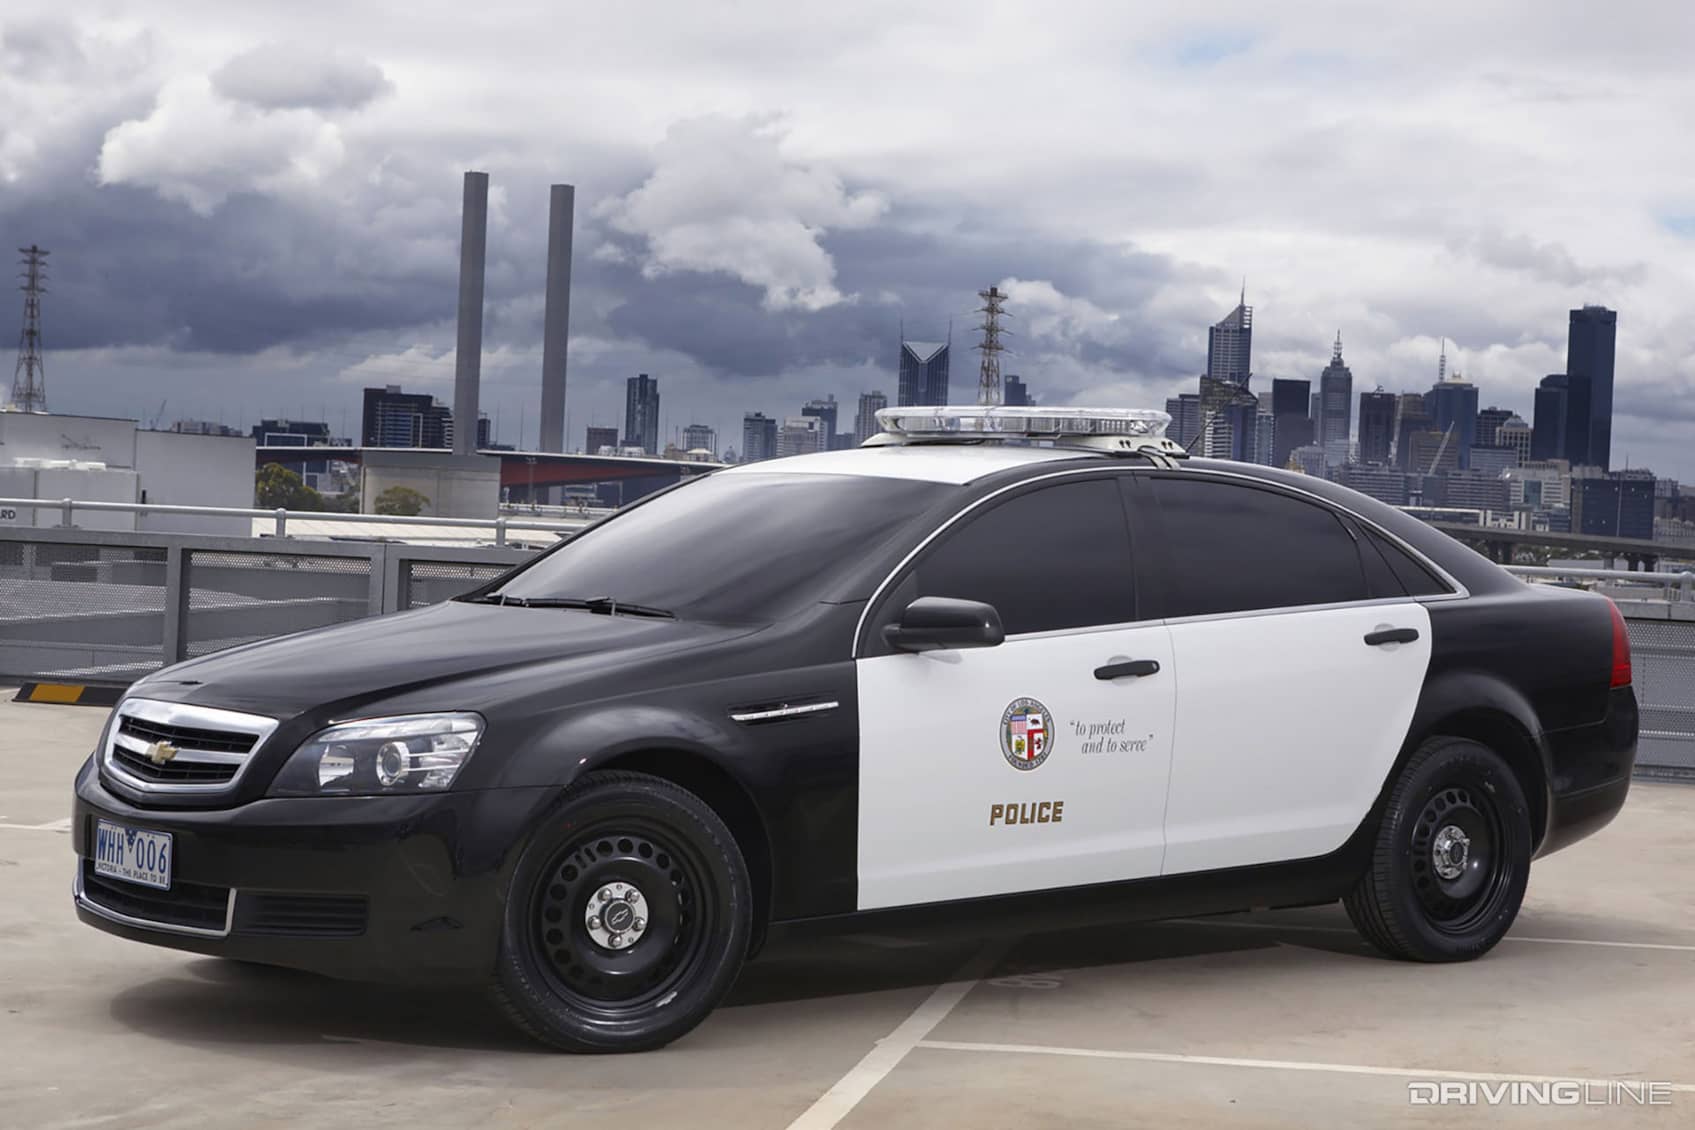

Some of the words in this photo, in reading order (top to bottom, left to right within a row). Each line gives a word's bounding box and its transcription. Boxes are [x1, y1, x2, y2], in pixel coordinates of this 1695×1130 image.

[0, 510, 16, 520] RD
[1088, 719, 1125, 740] protect
[1081, 736, 1104, 754] and
[1106, 738, 1118, 753] to
[990, 801, 1064, 826] POLICE
[97, 828, 124, 865] WHH
[136, 838, 167, 874] 006
